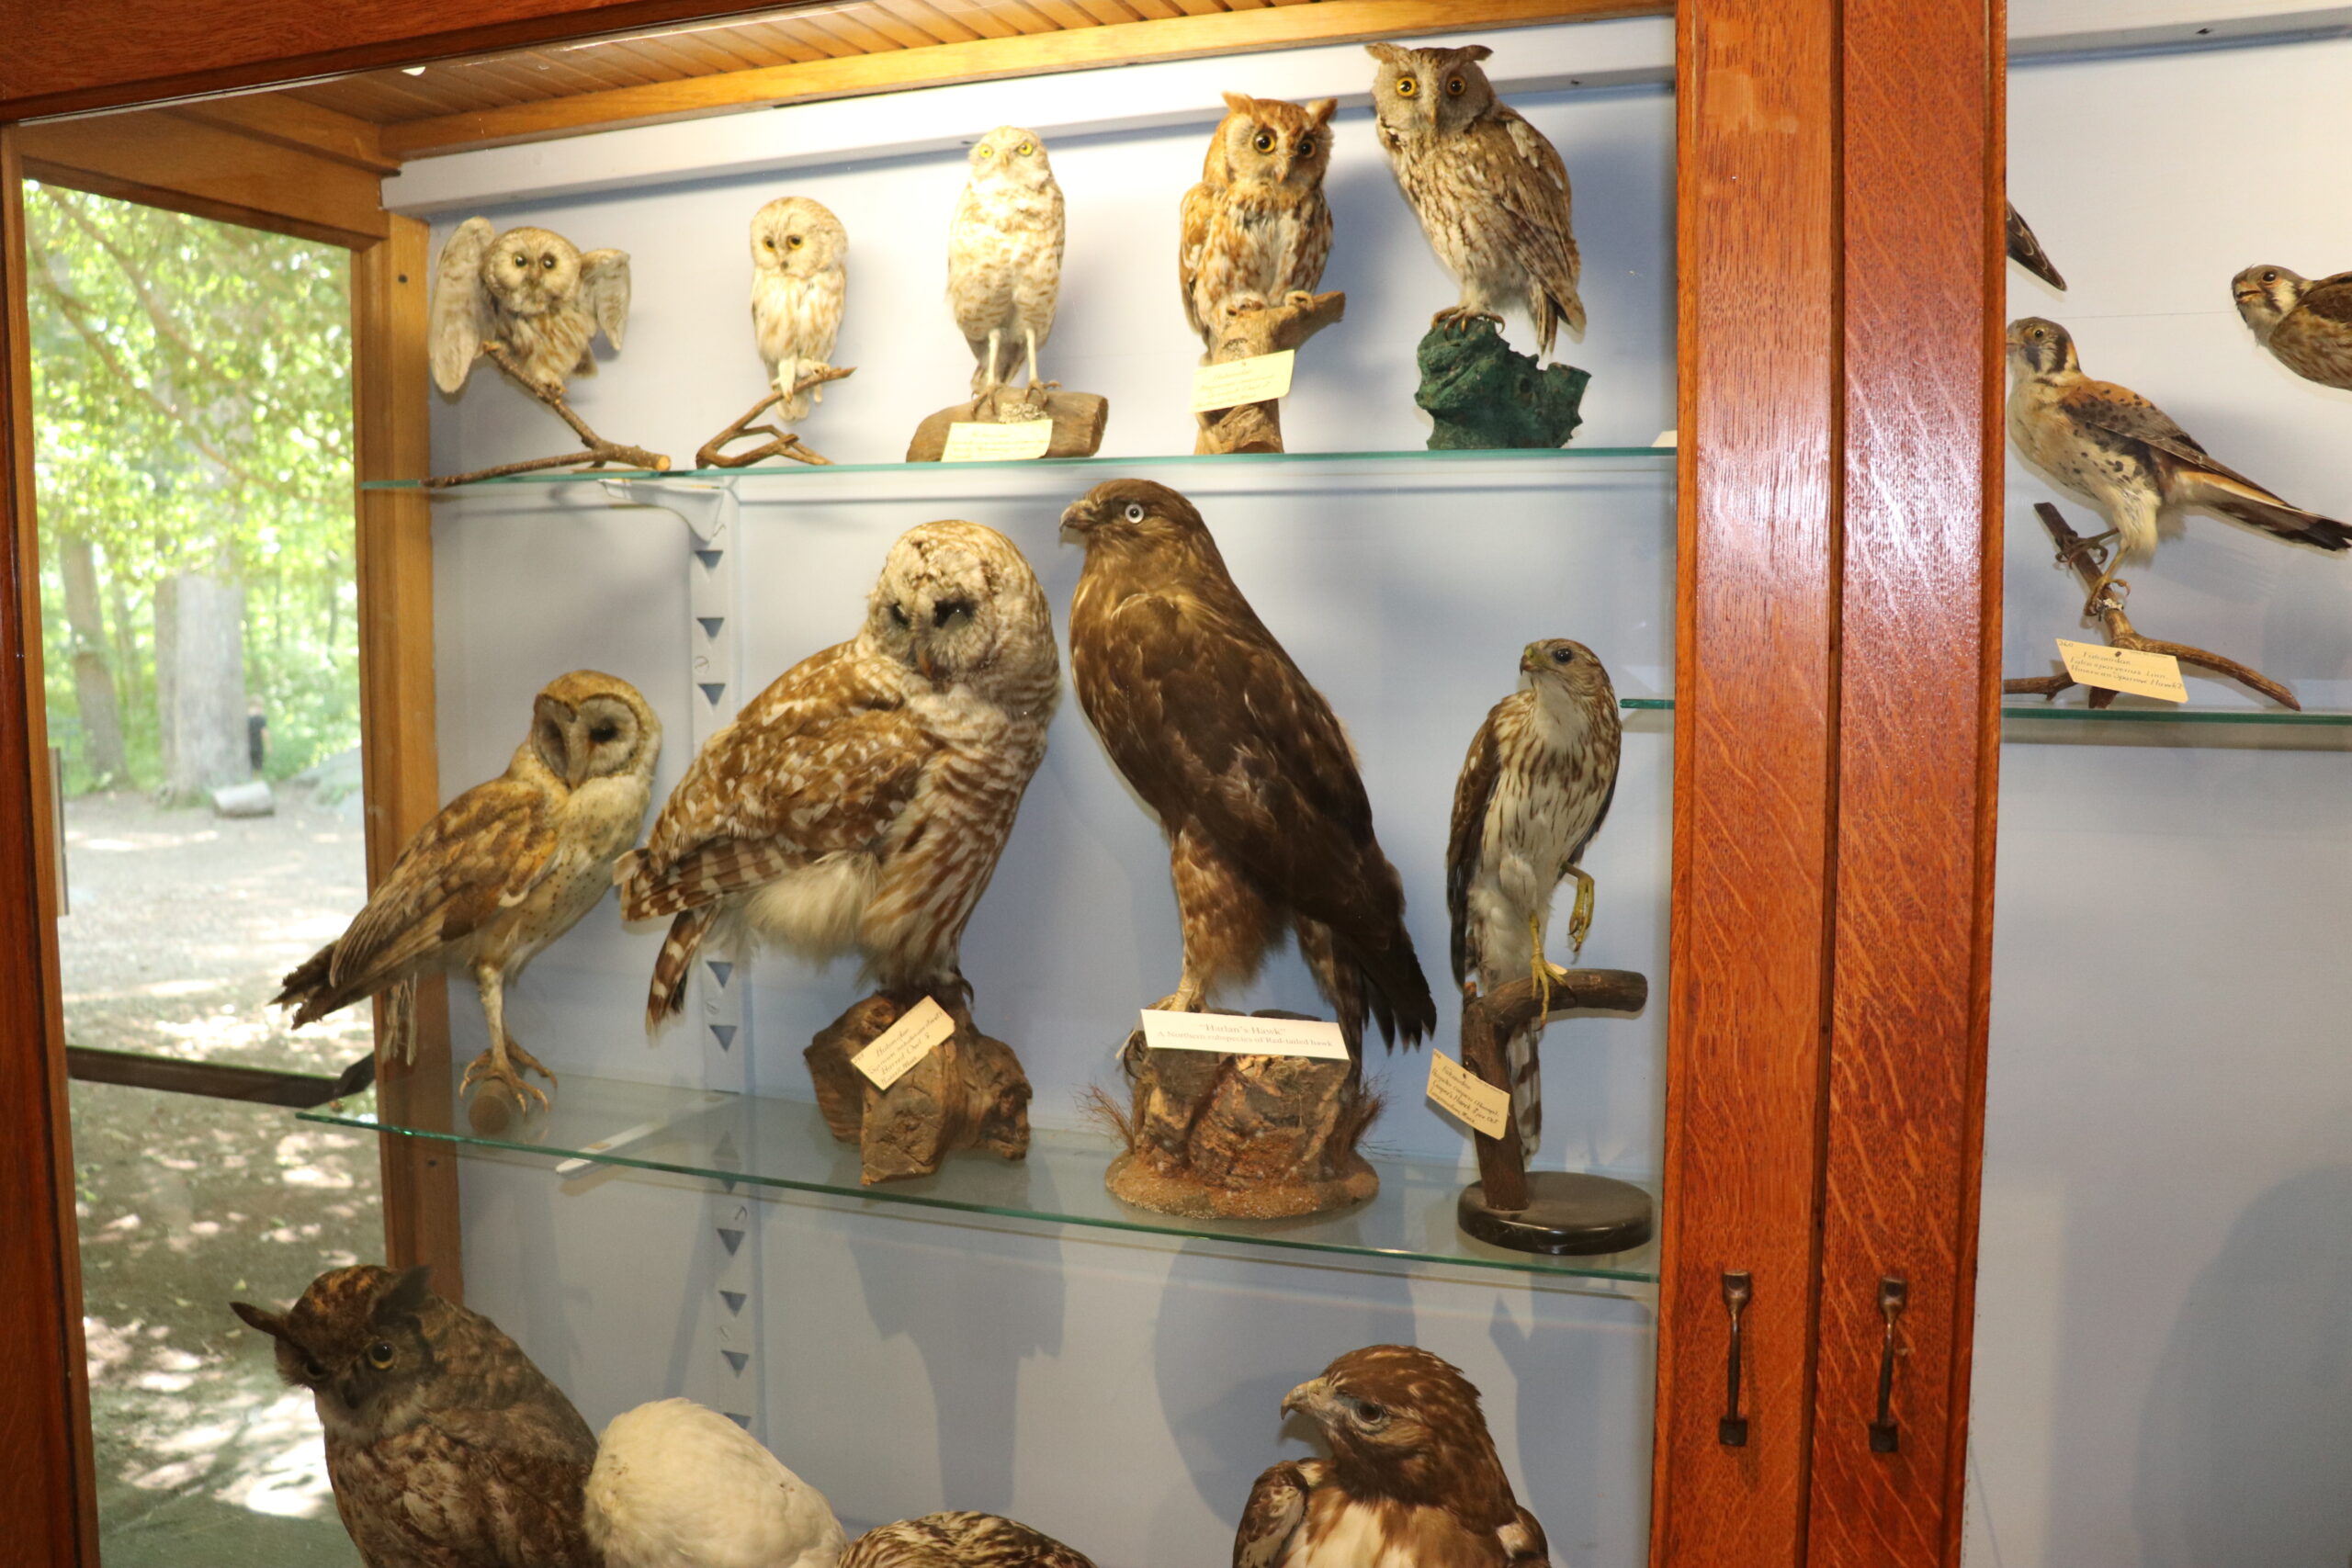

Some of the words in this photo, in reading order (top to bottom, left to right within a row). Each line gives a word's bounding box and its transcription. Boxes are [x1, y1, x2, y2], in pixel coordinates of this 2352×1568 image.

[1167, 1031, 1206, 1040] Northern
[1207, 1034, 1253, 1043] subspecies
[1265, 1036, 1309, 1045] Red-tailed
